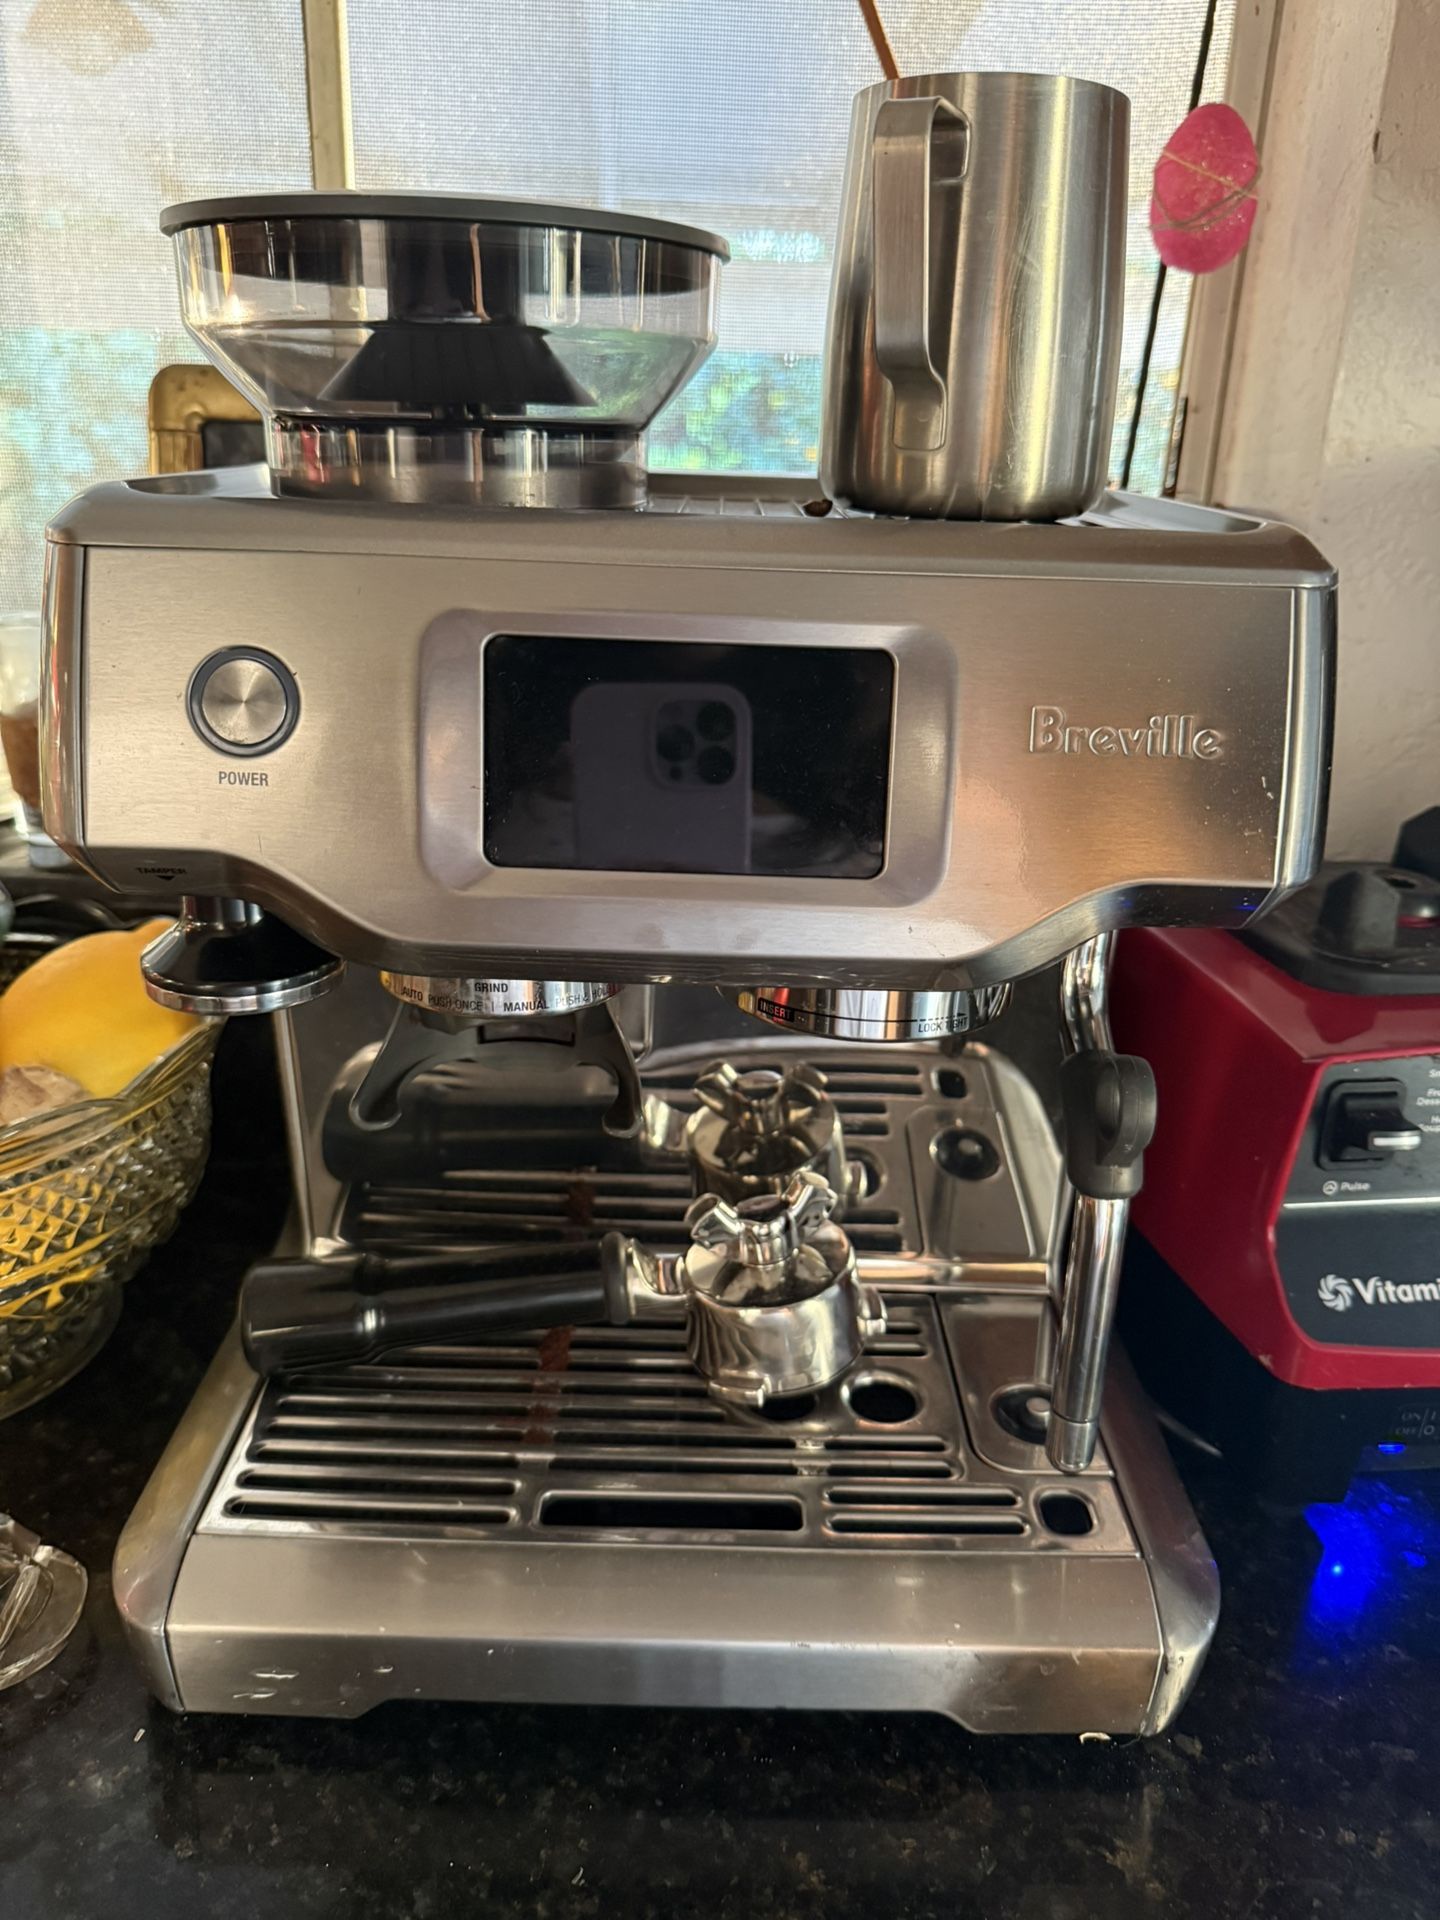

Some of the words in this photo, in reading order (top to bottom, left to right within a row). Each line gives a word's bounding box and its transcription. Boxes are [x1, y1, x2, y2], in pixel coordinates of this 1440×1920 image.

[1029, 705, 1225, 760] Breville
[218, 771, 269, 787] POWER
[135, 866, 187, 875] TAMPER
[474, 982, 508, 993] GRIND
[401, 986, 423, 1001] AUTO
[428, 993, 452, 1010] PUSH
[455, 999, 483, 1011] ONCE
[503, 1000, 549, 1012] MANUAL
[555, 993, 580, 1008] PUSH
[759, 999, 792, 1020] INSERT
[918, 1021, 942, 1033] LOCK
[1340, 1182, 1371, 1192] Pulse
